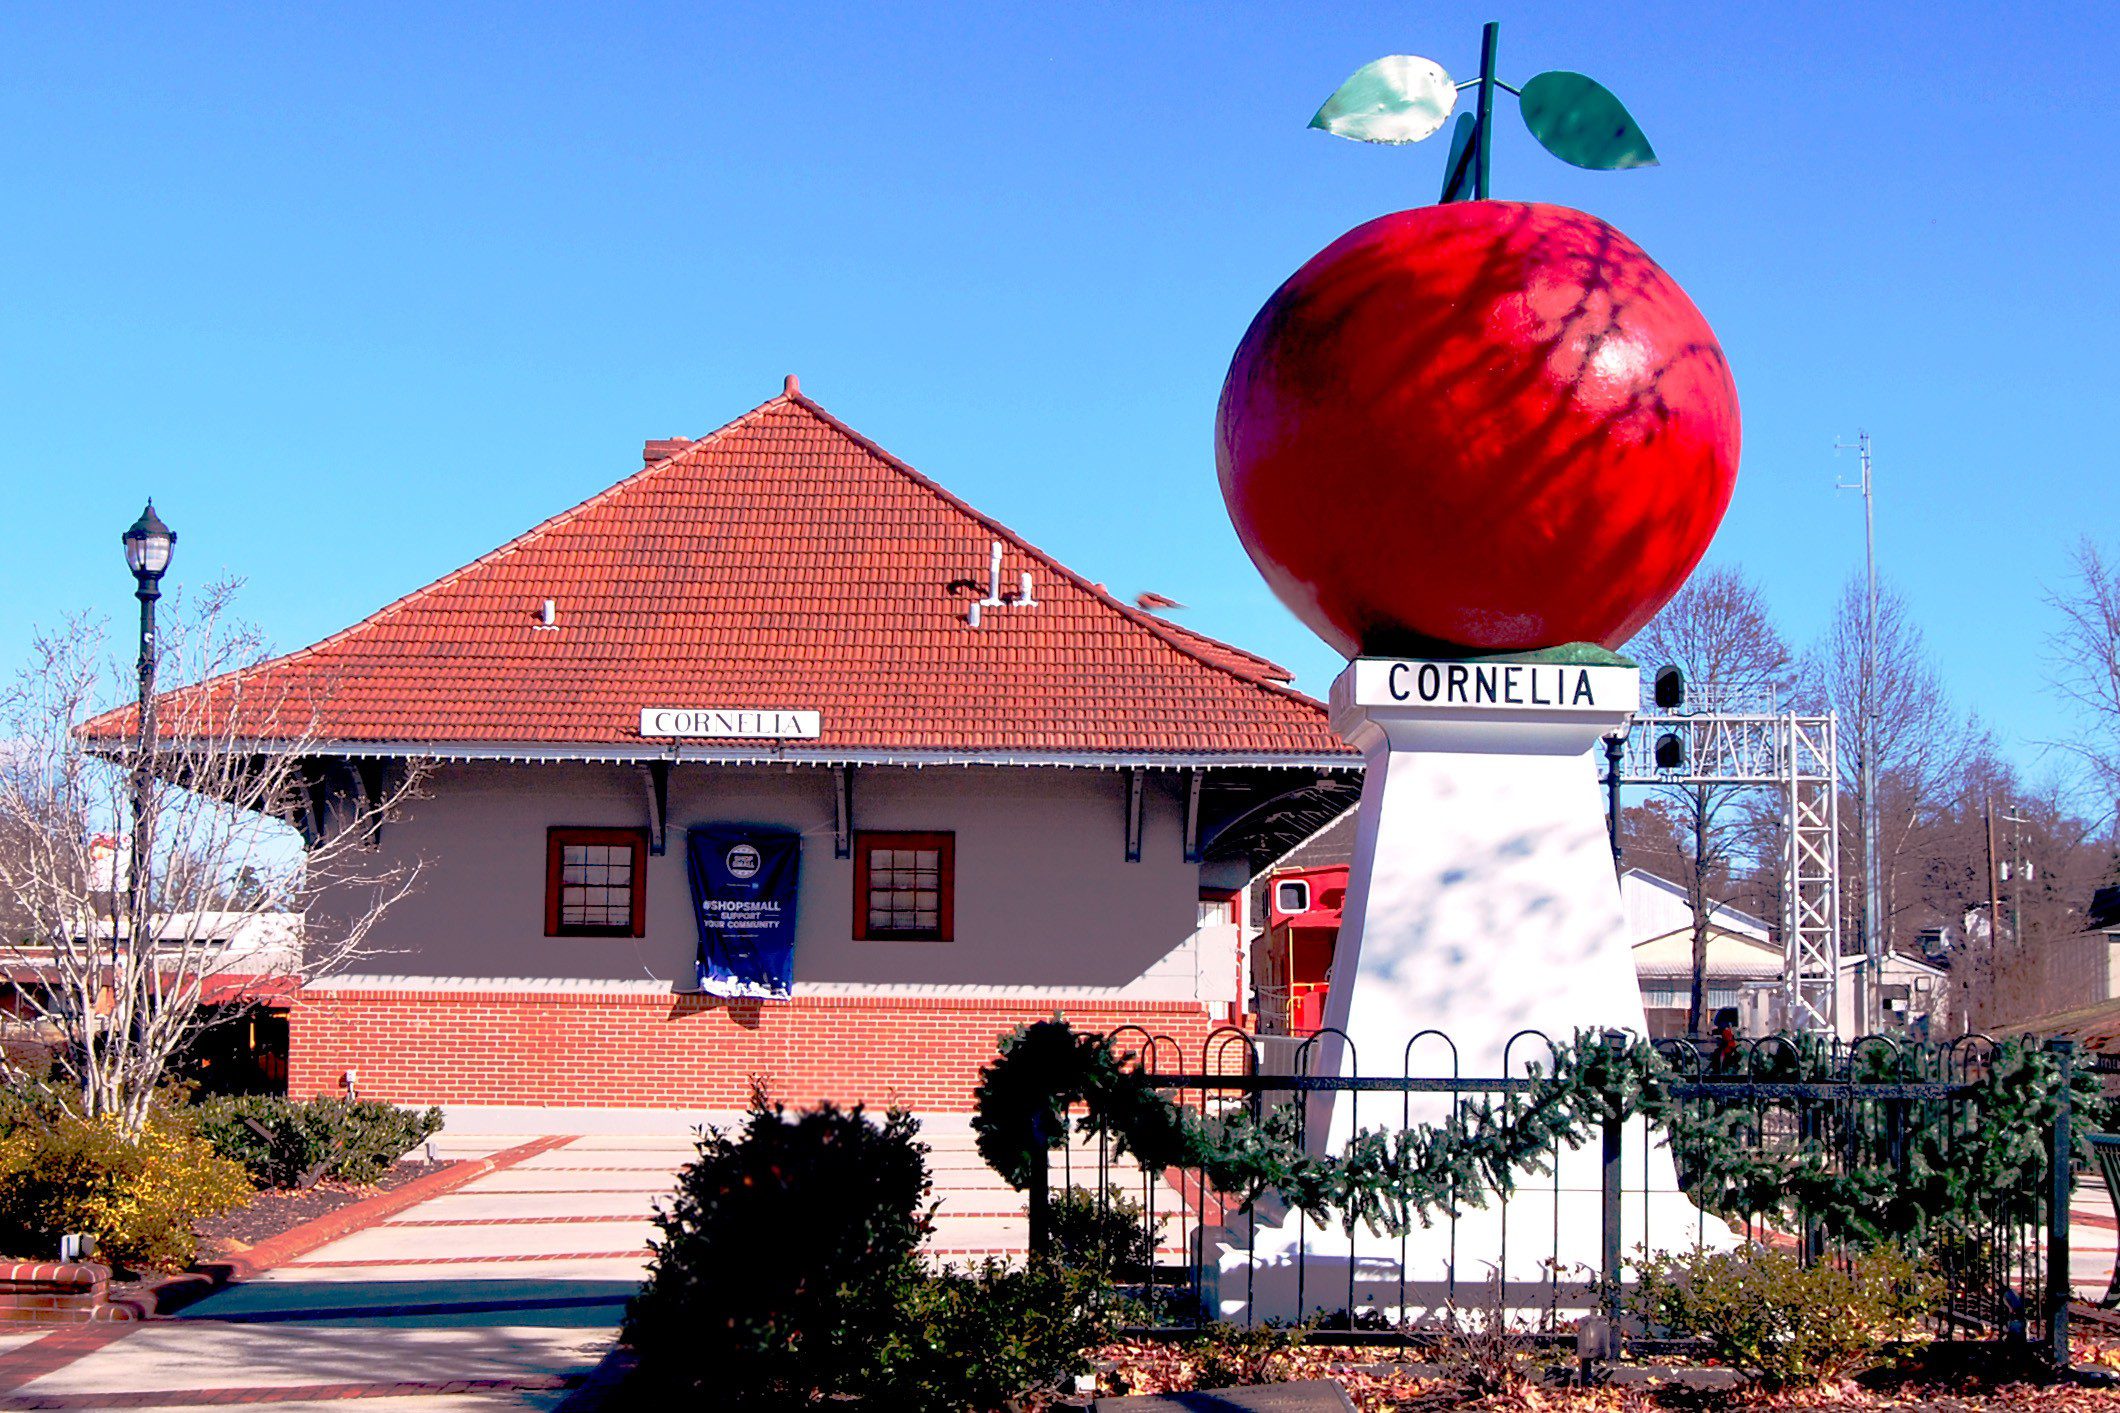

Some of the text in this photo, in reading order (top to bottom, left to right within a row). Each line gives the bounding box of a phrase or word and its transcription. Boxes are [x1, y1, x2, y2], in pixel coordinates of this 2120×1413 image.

[1388, 662, 1594, 705] CORNELIA
[655, 712, 802, 734] CORNELIA
[703, 900, 781, 912] #SHOPSMALL
[720, 912, 762, 920] SUPPORT
[704, 919, 780, 929] YOUR COMMUNITY
